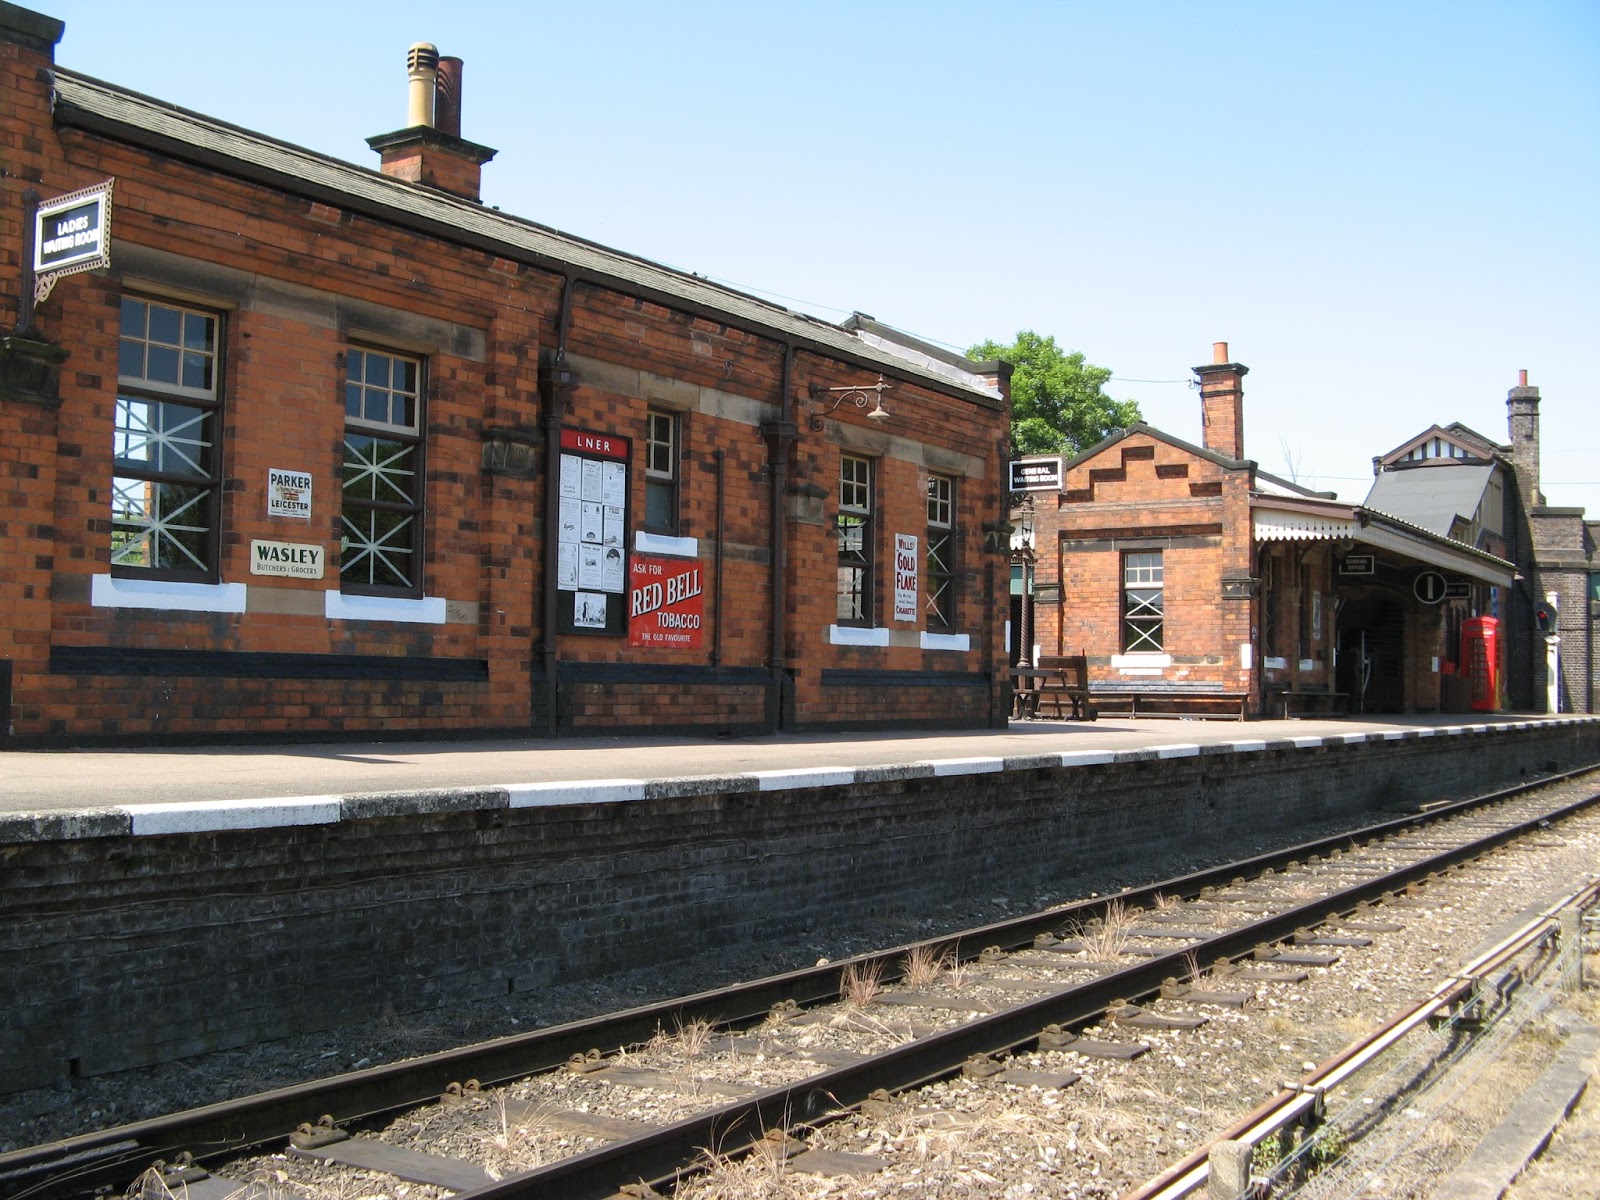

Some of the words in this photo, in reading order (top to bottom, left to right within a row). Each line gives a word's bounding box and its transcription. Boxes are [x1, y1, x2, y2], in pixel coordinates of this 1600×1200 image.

[58, 216, 88, 236] LADIES
[43, 233, 75, 255] WAITING
[75, 228, 100, 246] ROOM
[577, 435, 610, 452] LNER
[1020, 467, 1050, 475] GENERAL
[270, 474, 310, 489] PARKER
[1014, 475, 1039, 483] WAITING
[271, 499, 309, 511] LEICESTER
[257, 545, 319, 565] WASLEY
[256, 562, 287, 573] BUTCHERS
[291, 565, 317, 575] GROCERS
[632, 563, 647, 574] ASK
[649, 564, 663, 575] FOR
[631, 582, 663, 617] RED
[666, 568, 702, 606] BELL
[896, 605, 915, 615] CIGARETTE
[657, 612, 700, 630] TOBACCO
[642, 632, 651, 641] THE
[653, 633, 663, 641] OLD
[665, 633, 691, 642] FAVOURITE
